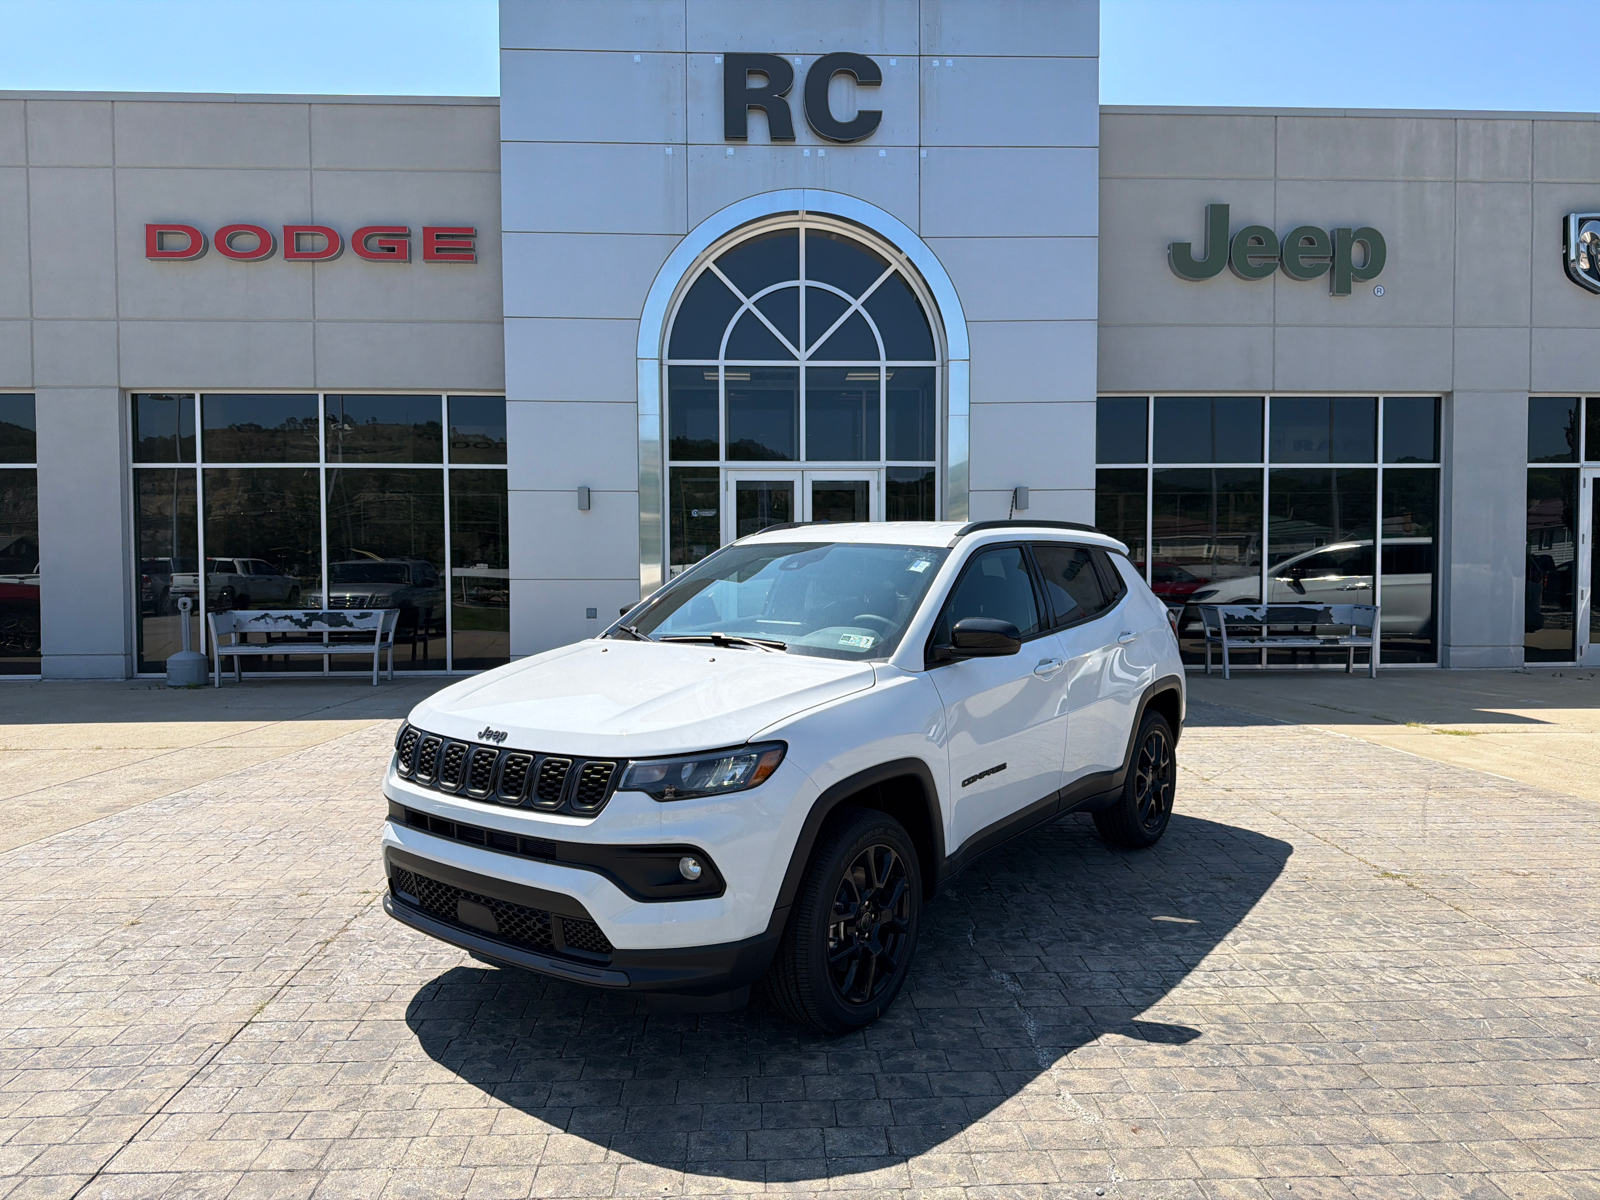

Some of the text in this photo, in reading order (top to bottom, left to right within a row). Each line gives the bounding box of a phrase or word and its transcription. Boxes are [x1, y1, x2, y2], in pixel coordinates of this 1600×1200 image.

[724, 52, 883, 143] RC
[146, 224, 477, 263] DODGE
[1168, 204, 1387, 297] Jeep
[477, 726, 508, 744] Jeep
[961, 762, 1008, 788] COMPASS
